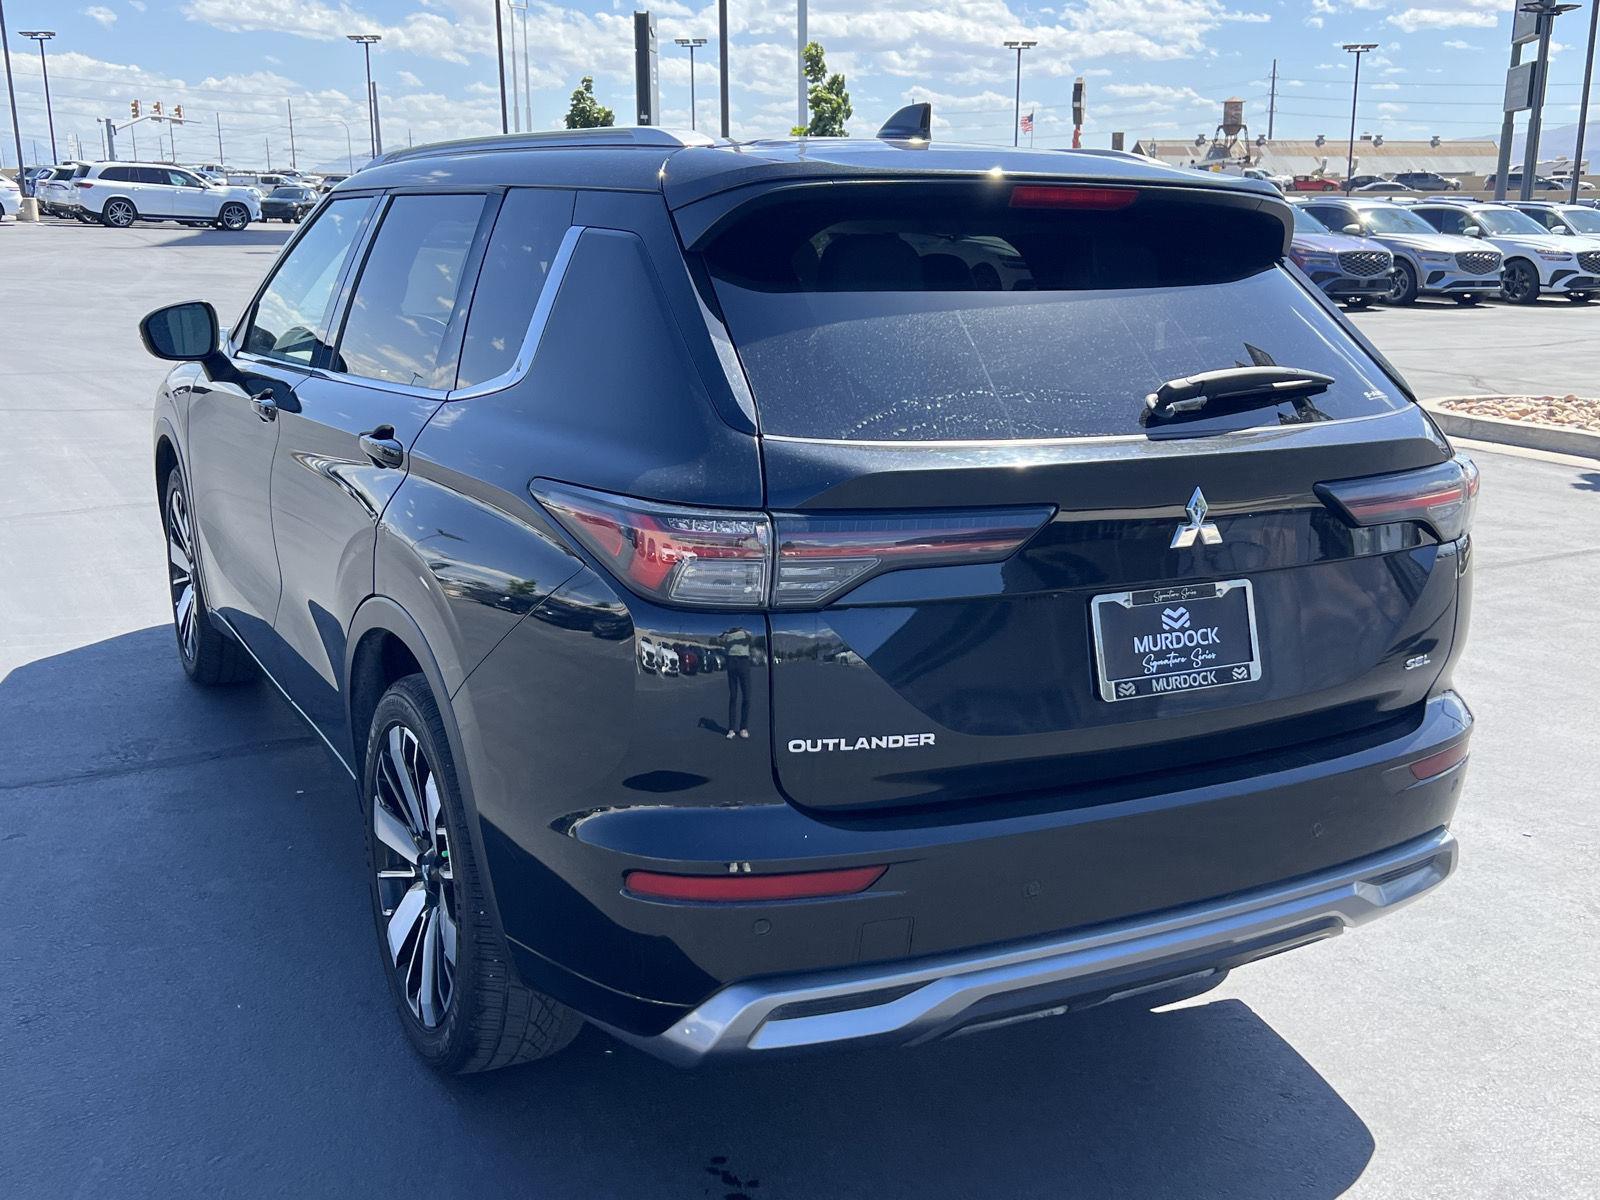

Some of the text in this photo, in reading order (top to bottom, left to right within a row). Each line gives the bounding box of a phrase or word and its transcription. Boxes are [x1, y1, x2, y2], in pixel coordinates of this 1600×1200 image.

[1133, 627, 1220, 653] MURDOCK
[1142, 648, 1217, 674] Signature Series
[1152, 671, 1217, 692] MURDOCK
[787, 733, 936, 753] OUTLANDER
